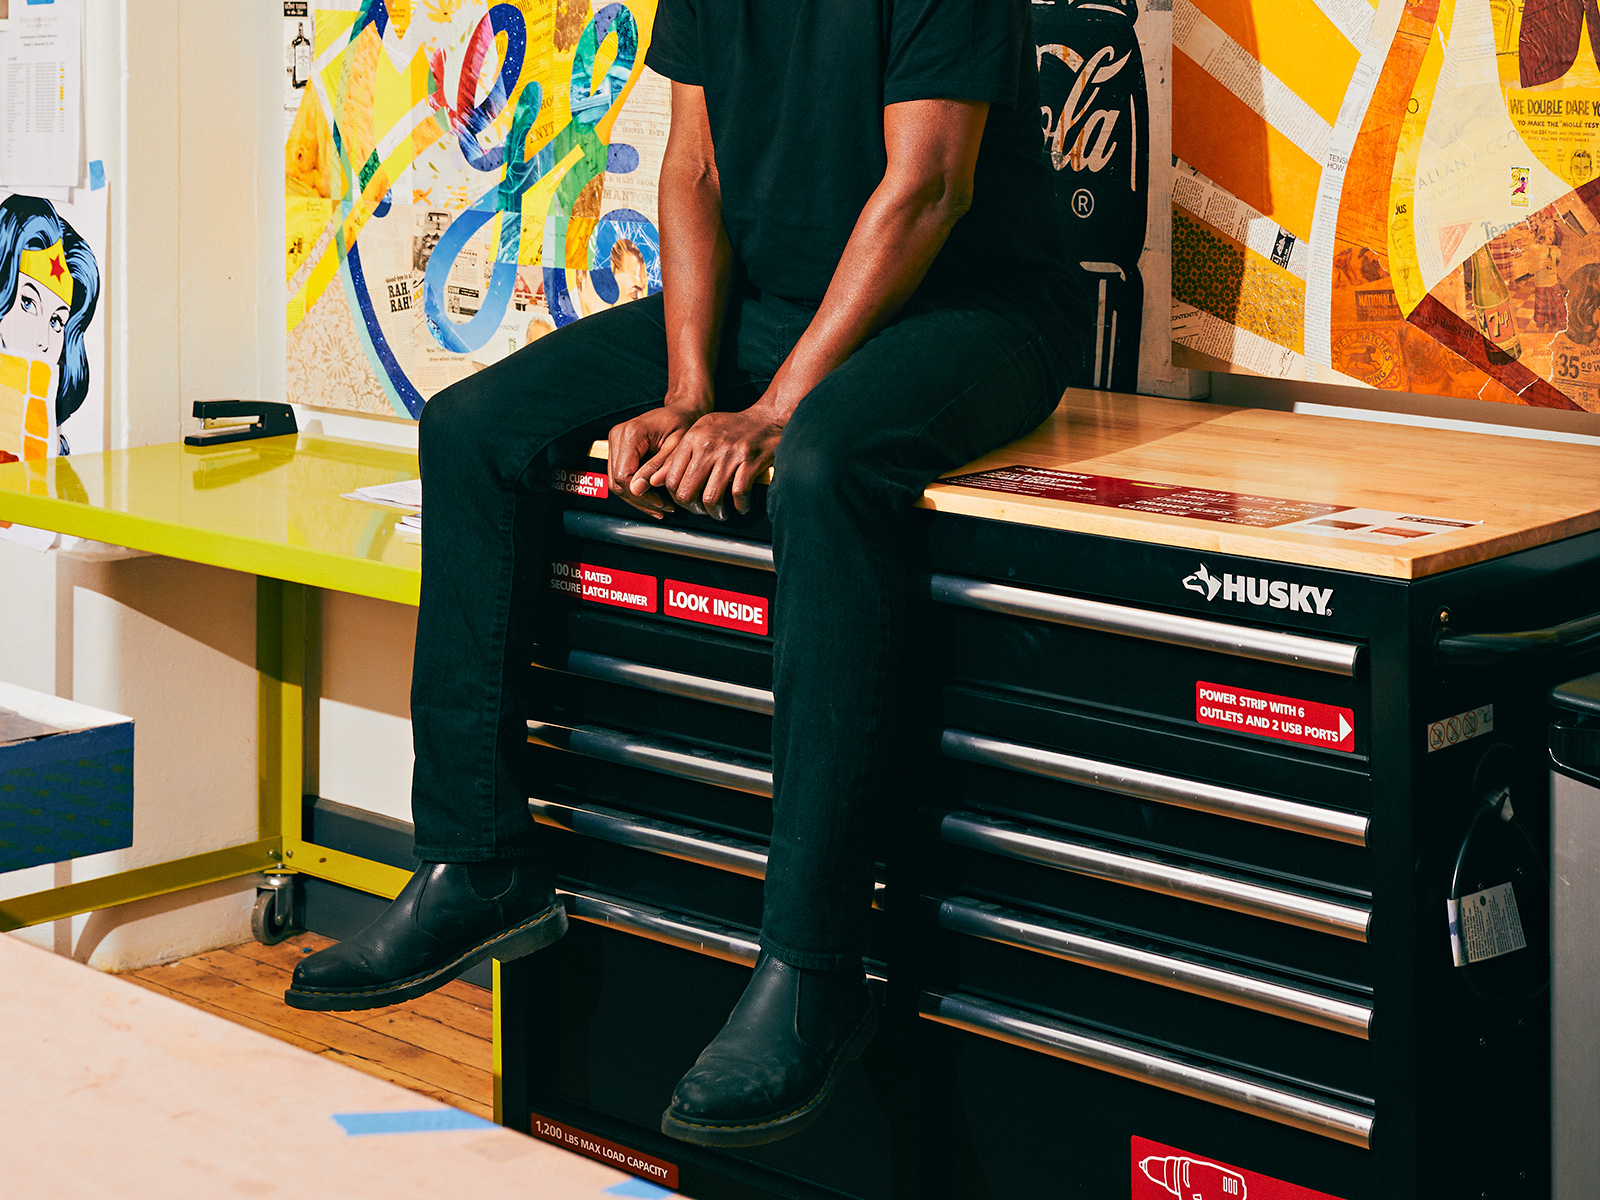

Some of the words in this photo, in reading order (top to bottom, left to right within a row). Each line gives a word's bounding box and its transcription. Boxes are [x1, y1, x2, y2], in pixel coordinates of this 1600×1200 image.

[1510, 99, 1525, 114] WE
[1528, 99, 1562, 116] DOUBLE
[1566, 100, 1590, 116] DARE
[1327, 162, 1344, 172] HOW
[1418, 158, 1466, 190] ALLAN
[388, 282, 410, 298] RAH,
[1358, 294, 1392, 307] NATIONAL
[390, 296, 412, 313] RAH!
[1368, 308, 1400, 316] SEPTEMBER
[1332, 334, 1354, 364] SAFETY
[1356, 330, 1393, 361] MATCHES
[566, 484, 598, 496] CAPACITY
[569, 474, 593, 486] CUBIC
[594, 477, 604, 488] IN
[551, 562, 569, 576] 100
[571, 568, 584, 580] LB.
[585, 570, 612, 584] RATED
[550, 579, 581, 594] SECURE
[583, 585, 609, 600] LATCH
[610, 591, 648, 607] DRAWER
[1223, 572, 1334, 616] HUSKY
[668, 589, 709, 614] LOOK
[714, 599, 763, 624] INSIDE
[1200, 688, 1236, 706] POWER
[1240, 696, 1268, 710] STRIP
[1270, 702, 1296, 716] WITH
[1298, 706, 1305, 718] 6
[1200, 706, 1244, 724] OUTLETS
[1246, 714, 1270, 729] AND
[1272, 719, 1279, 730] 2
[1281, 722, 1303, 735] USB
[1304, 726, 1339, 742] PORTS
[536, 1120, 562, 1140] 1,200
[564, 1132, 580, 1146] LBS
[580, 1138, 601, 1154] MAX
[602, 1146, 626, 1163] LOAD
[627, 1156, 668, 1180] CAPACITY
